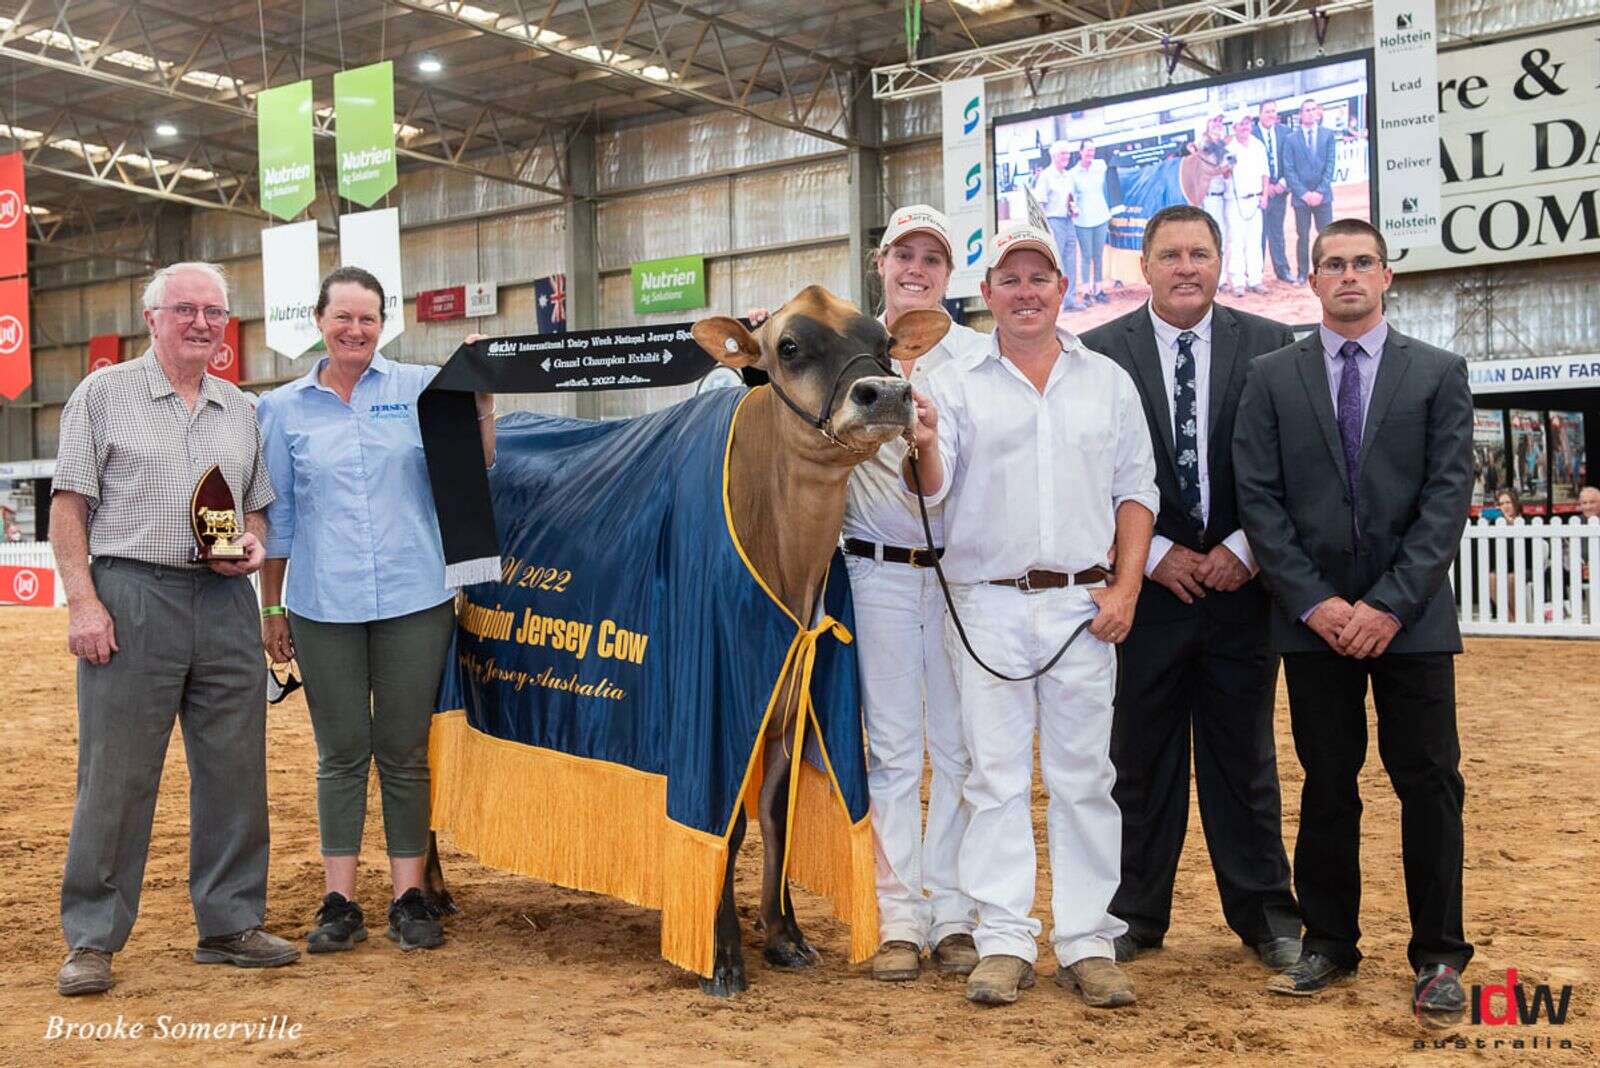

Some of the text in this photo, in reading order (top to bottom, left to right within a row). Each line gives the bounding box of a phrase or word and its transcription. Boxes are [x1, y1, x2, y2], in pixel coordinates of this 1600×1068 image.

[1380, 31, 1432, 48] Holstein
[1513, 48, 1569, 101] &
[1391, 77, 1422, 92] Lead
[1380, 113, 1435, 129] Innovate
[343, 146, 392, 171] Nutrien
[1386, 156, 1432, 171] Deliver
[264, 163, 311, 184] Nutrien
[1385, 214, 1437, 230] Holstein
[641, 268, 696, 290] Nutrien
[519, 339, 564, 351] International
[567, 338, 590, 349] Dairy
[591, 336, 613, 347] Week
[614, 333, 645, 345] National
[647, 332, 675, 342] Jersey
[553, 352, 660, 368] Grand Champion Exhibit
[592, 375, 616, 386] 2022
[1512, 365, 1562, 381] DAIRY
[517, 566, 573, 593] 2022
[515, 606, 594, 660] Jersey
[597, 619, 650, 666] Cow
[482, 656, 529, 692] Jersey
[528, 666, 626, 701] Australia
